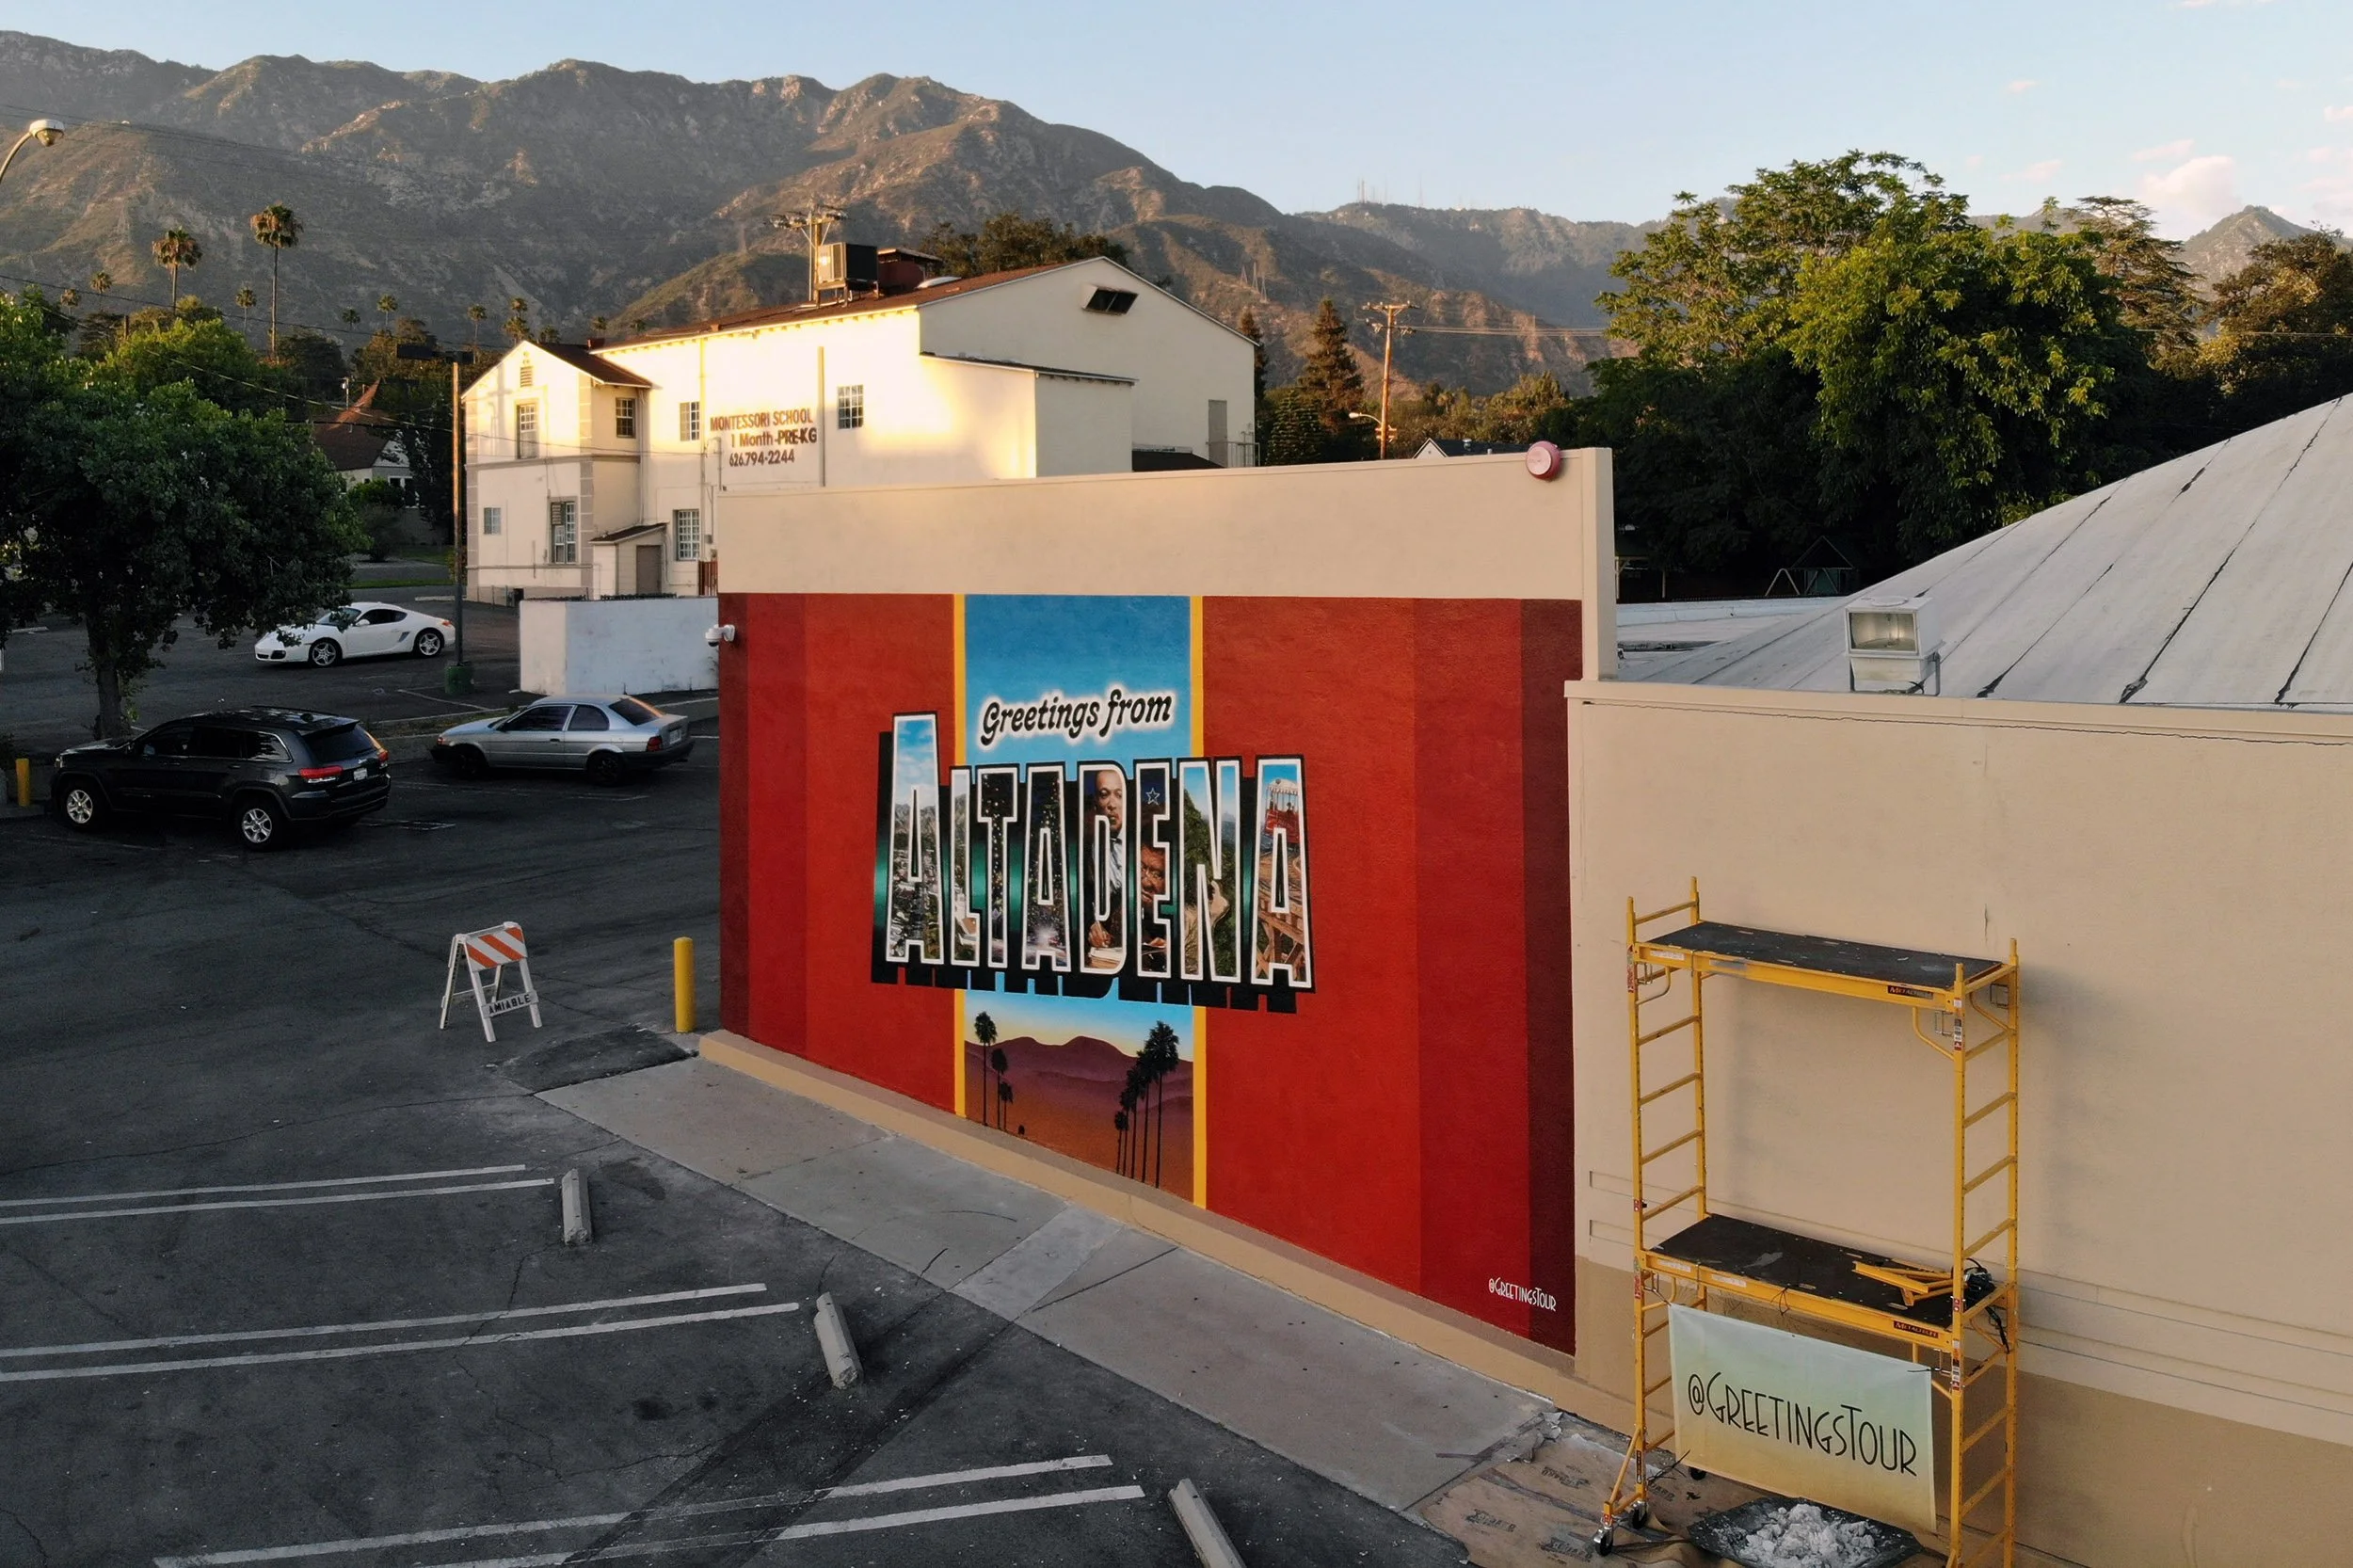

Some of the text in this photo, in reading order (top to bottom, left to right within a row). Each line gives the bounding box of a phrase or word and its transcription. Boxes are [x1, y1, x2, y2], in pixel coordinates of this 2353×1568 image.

[710, 408, 814, 431] MONTESSORI SCHOOL
[730, 434, 735, 448] 1
[981, 689, 1173, 746] Greetings from
[885, 712, 1315, 994] ALTADENA
[488, 994, 531, 1015] AMIABLE
